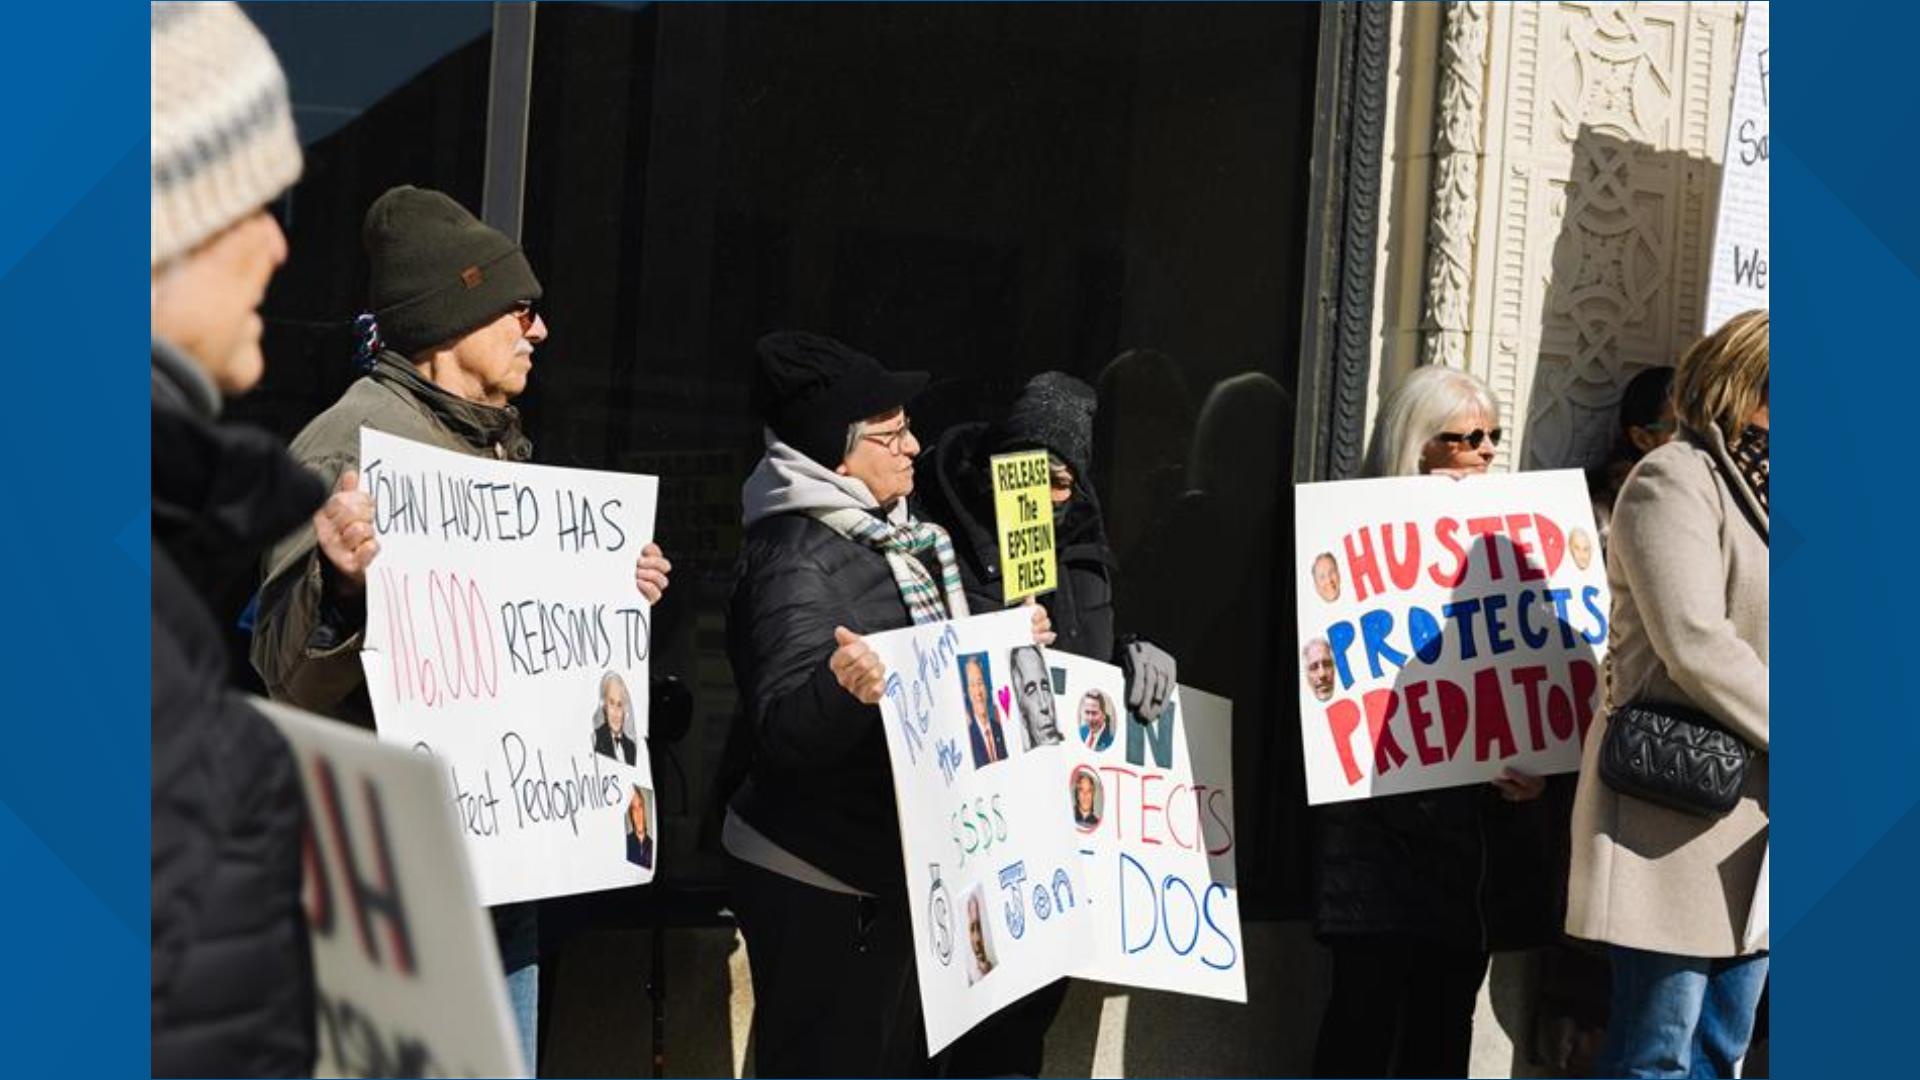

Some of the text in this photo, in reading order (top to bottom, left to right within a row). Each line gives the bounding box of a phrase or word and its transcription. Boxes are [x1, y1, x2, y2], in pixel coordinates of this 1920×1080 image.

[438, 471, 539, 542] HUSTED
[555, 489, 626, 553] HAS
[998, 458, 1047, 492] RELEASE
[1017, 493, 1038, 523] The
[1007, 524, 1052, 560] EPSTEIN
[1017, 557, 1046, 592] FILES
[1344, 512, 1567, 602] HUSTED
[501, 599, 614, 676] REASONS
[615, 608, 650, 670] TO
[1326, 584, 1610, 691] PROTECTS
[502, 731, 623, 837] Pedophiles
[1069, 764, 1233, 857] OTECTS
[1080, 848, 1237, 971] DOS
